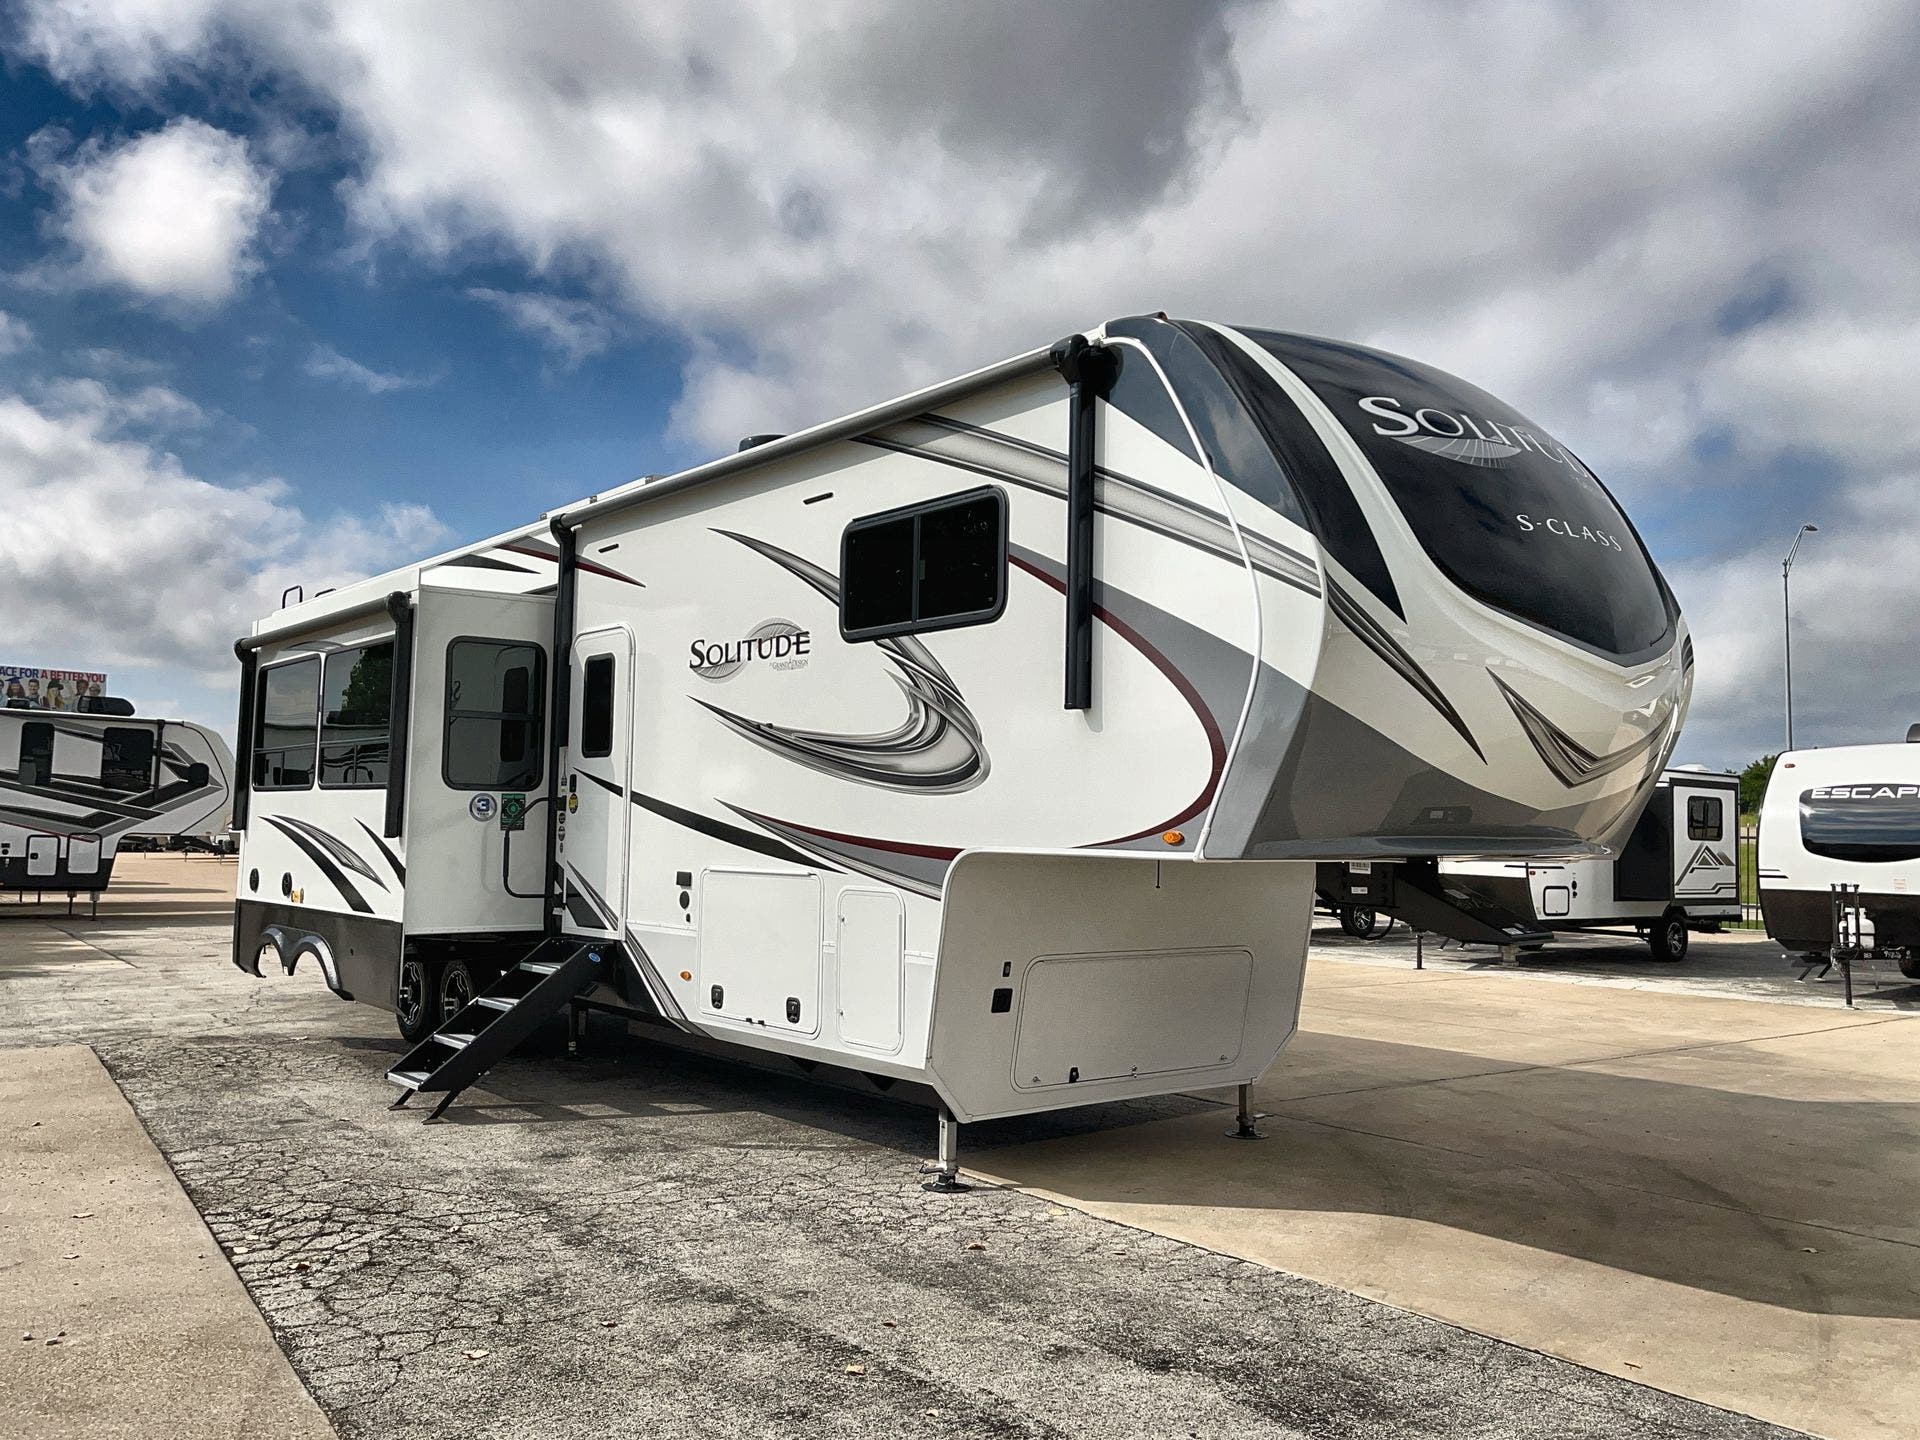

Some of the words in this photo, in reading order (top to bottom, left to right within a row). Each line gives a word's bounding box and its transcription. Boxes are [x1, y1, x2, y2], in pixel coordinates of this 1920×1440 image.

[1516, 514, 1622, 552] S-CLASS
[689, 630, 811, 669] SOLITUDE
[19, 667, 39, 679] FOR
[41, 669, 48, 680] A
[50, 670, 83, 681] BETTER
[86, 672, 106, 683] YOU
[1810, 786, 1920, 799] ESCAP
